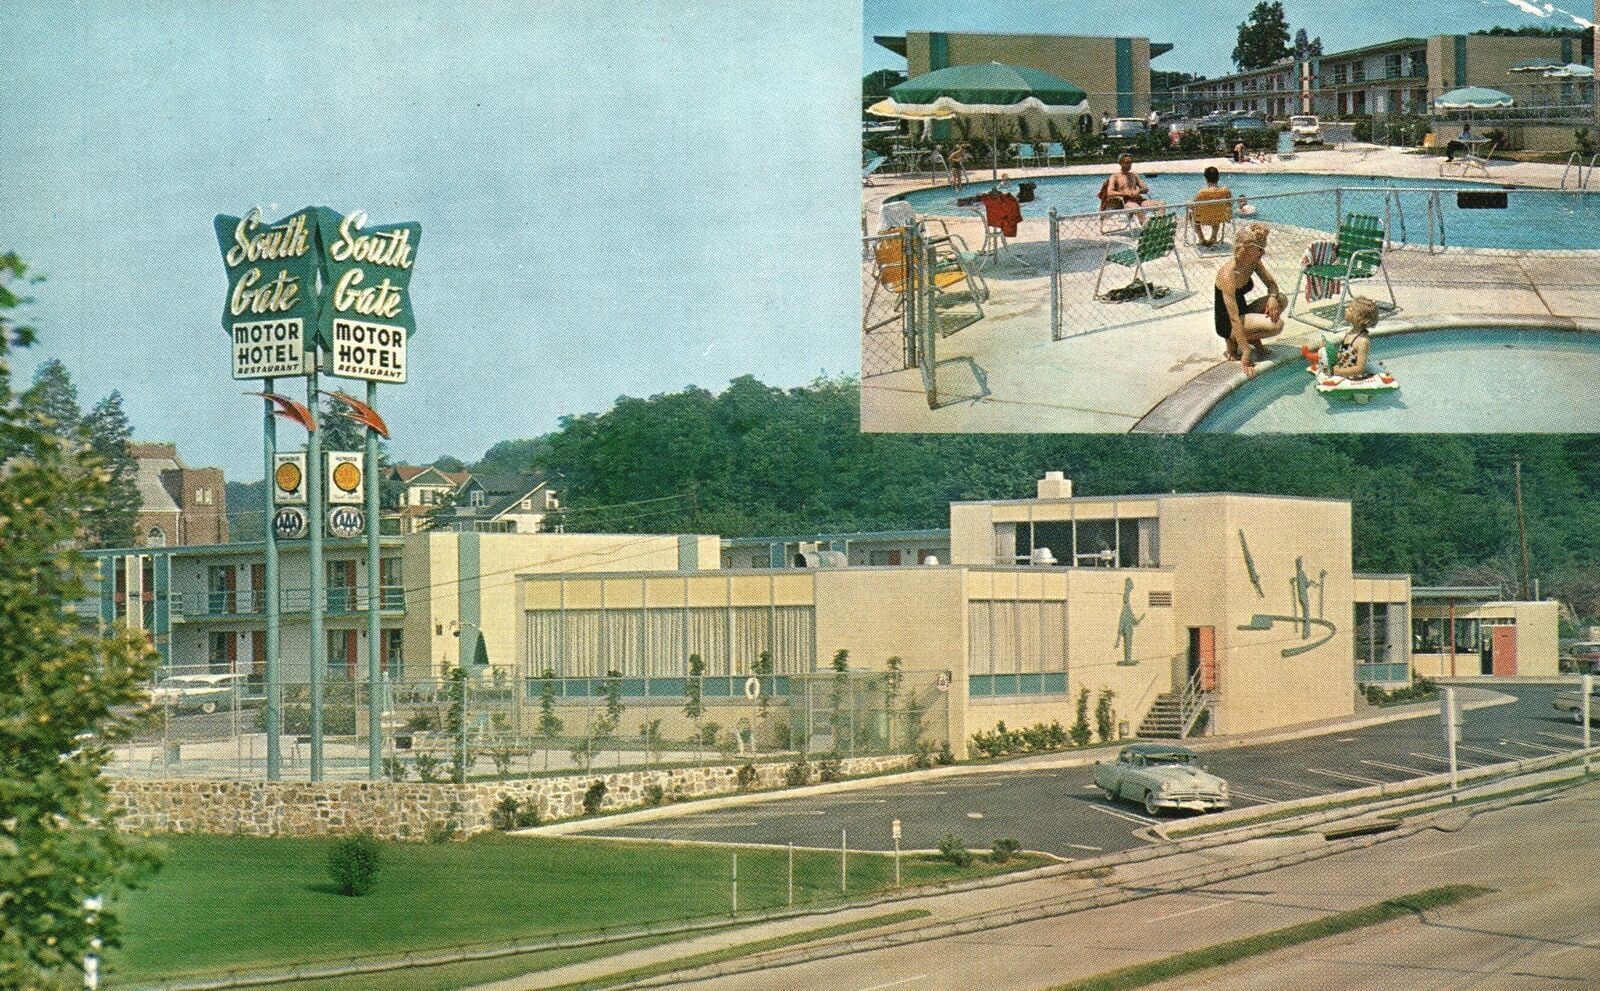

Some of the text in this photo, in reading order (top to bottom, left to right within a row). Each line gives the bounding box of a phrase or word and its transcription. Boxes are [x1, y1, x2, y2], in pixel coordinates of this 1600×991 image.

[227, 207, 309, 267] South
[330, 209, 412, 269] South
[231, 267, 300, 316] Gate
[334, 268, 402, 317] Gate
[235, 322, 299, 344] MOTOR
[336, 322, 402, 348] MOTOR
[238, 344, 299, 365] HOTEL
[339, 345, 402, 369] HOTEL
[237, 364, 299, 374] RESTAURANT
[338, 364, 402, 378] RESTAURANT
[277, 513, 300, 532] AAA
[336, 512, 361, 532] AAA
